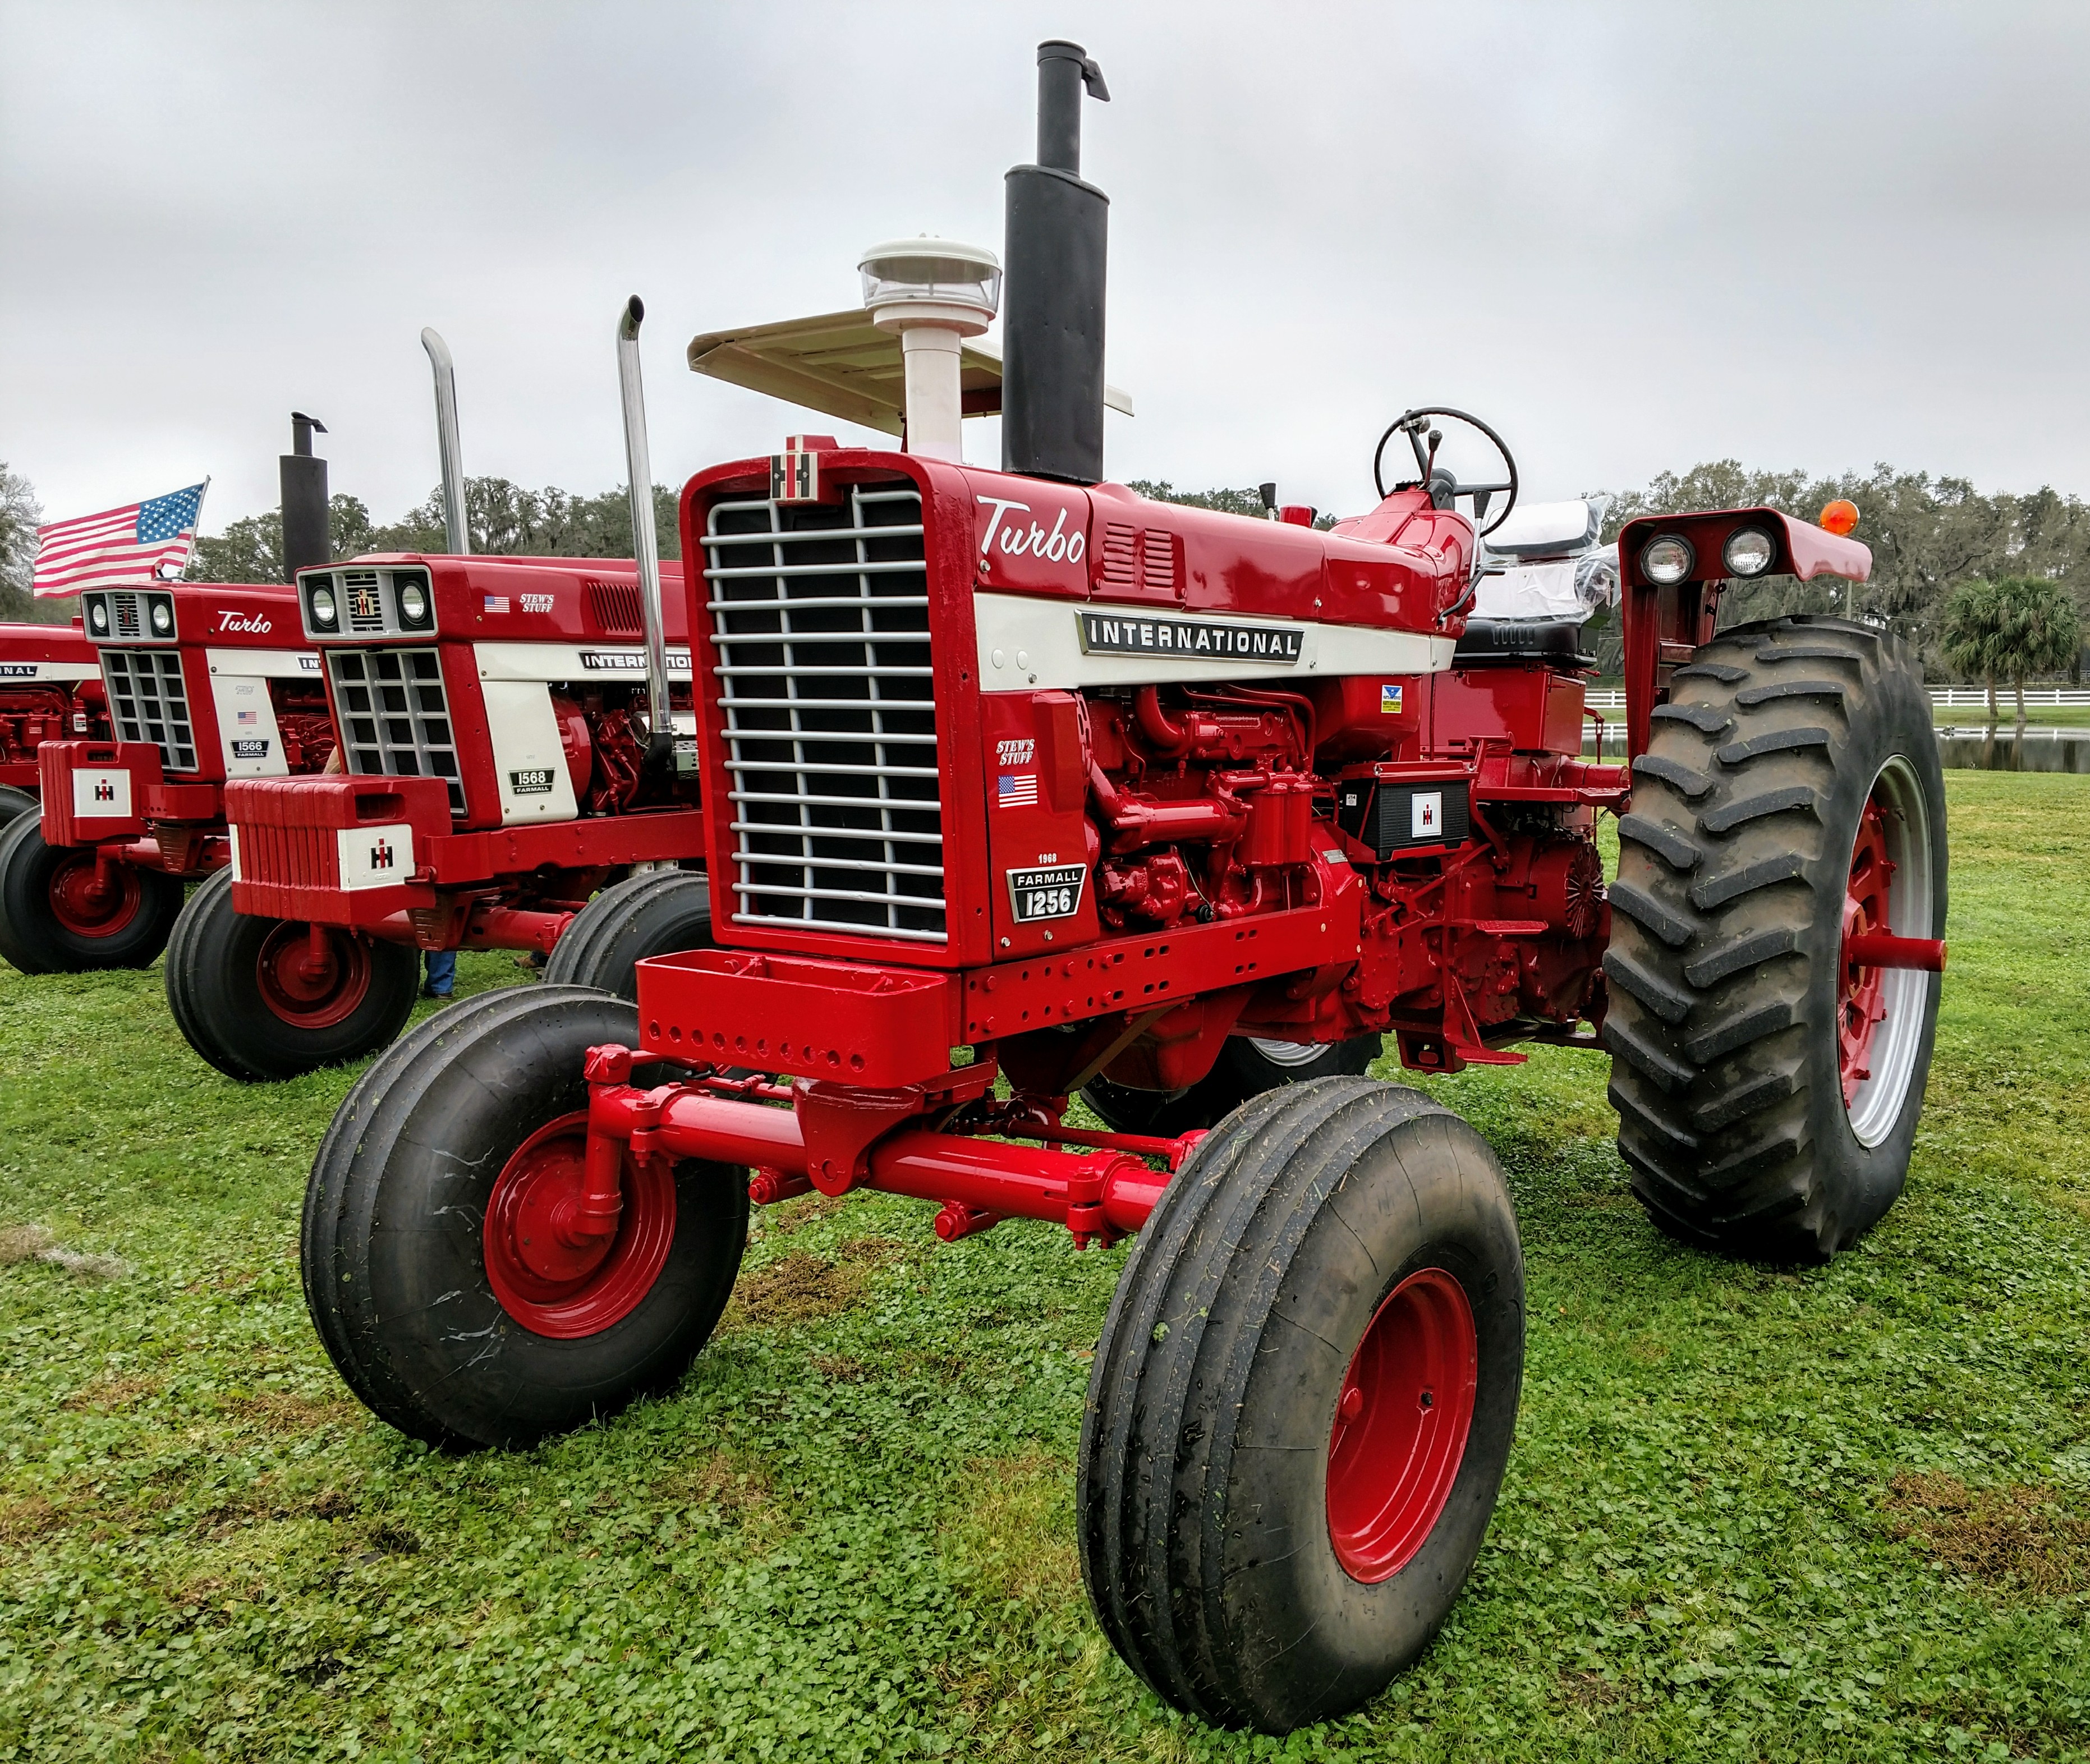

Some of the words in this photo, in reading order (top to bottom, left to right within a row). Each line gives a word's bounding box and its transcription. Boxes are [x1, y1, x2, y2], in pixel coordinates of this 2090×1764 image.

[976, 495, 1085, 564] Turbo
[520, 594, 554, 603] STEW'S
[522, 603, 553, 613] STUFF
[218, 610, 272, 633] Turbo
[1091, 619, 1297, 655] INTERNATIONAL
[302, 659, 321, 668] IN
[238, 742, 262, 751] 1566
[996, 739, 1035, 754] STEW'S
[999, 751, 1033, 766] STUFF
[518, 771, 546, 784] 1568
[1038, 853, 1057, 864] 1968
[1018, 871, 1078, 886] FARMALL
[1026, 888, 1071, 917] 1256
